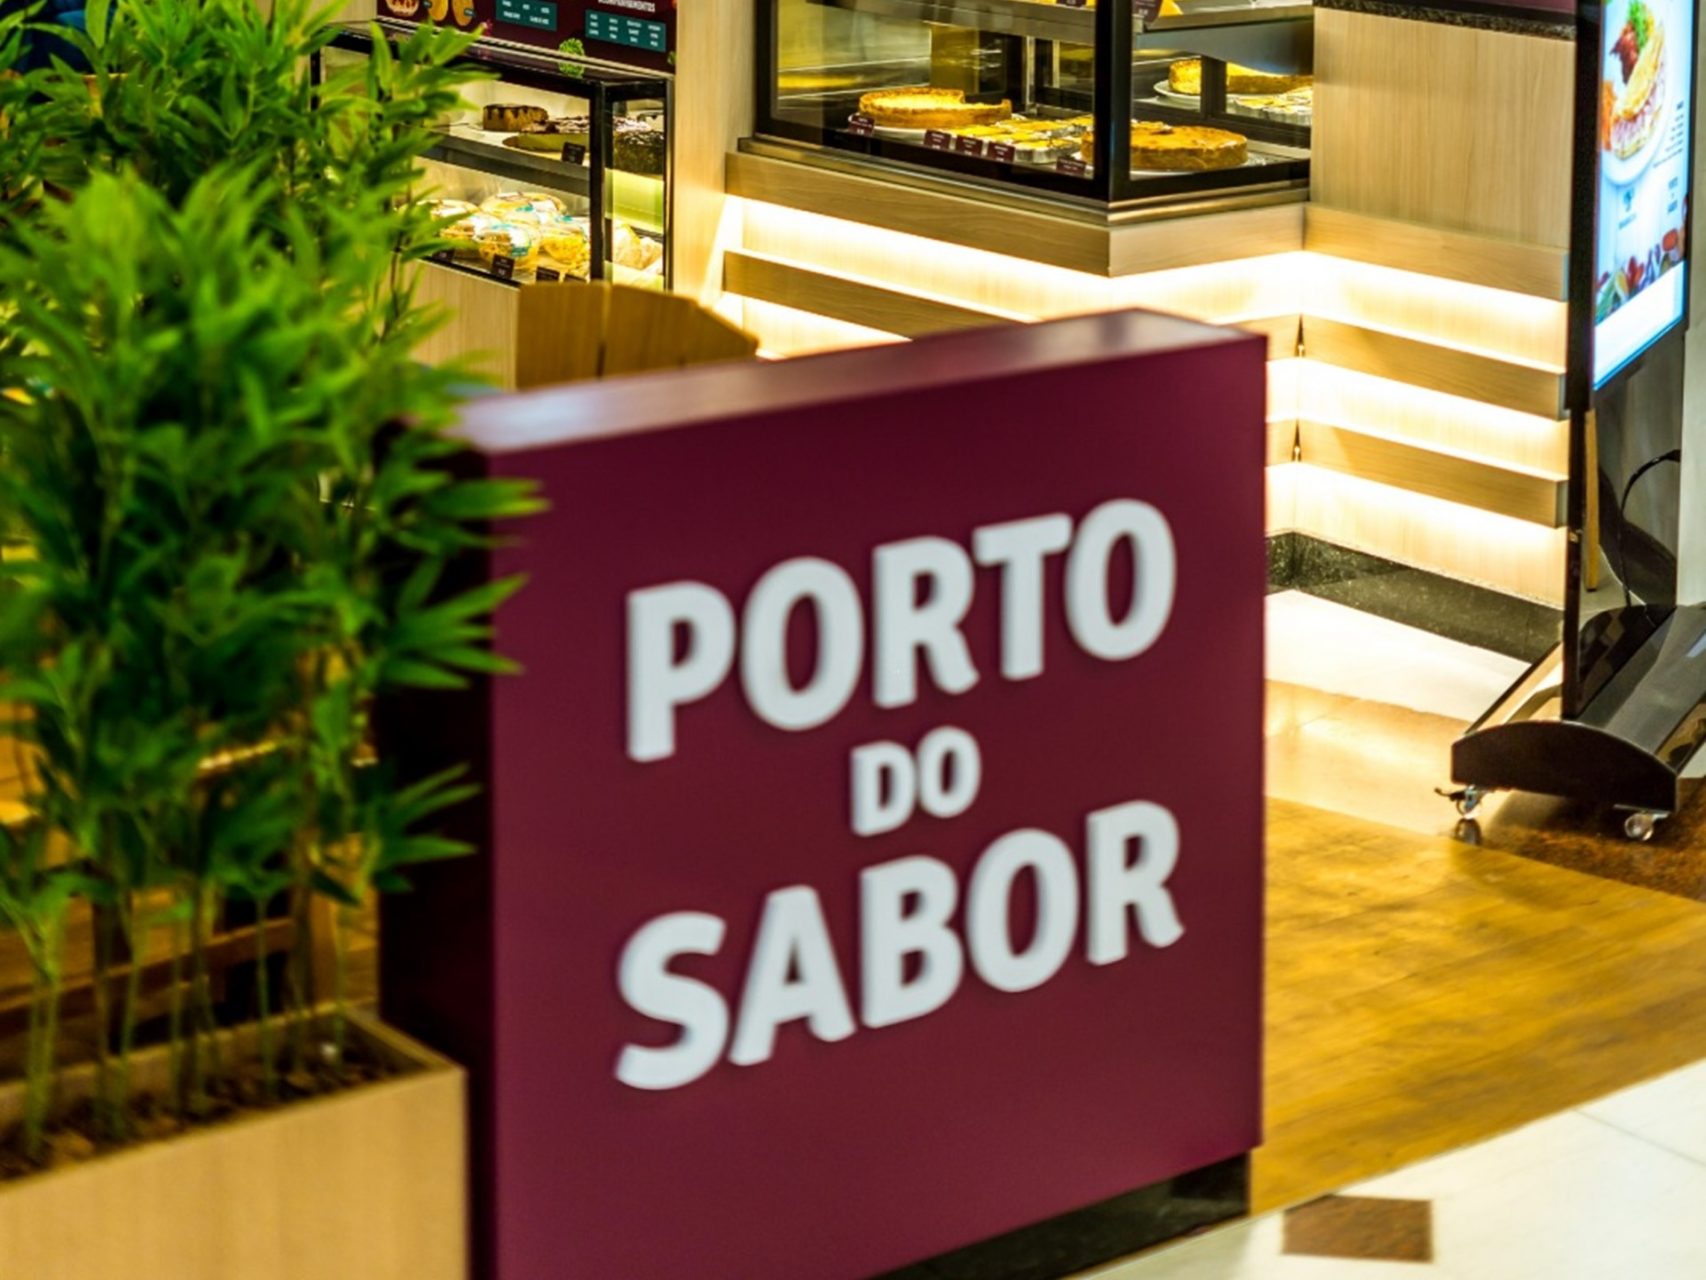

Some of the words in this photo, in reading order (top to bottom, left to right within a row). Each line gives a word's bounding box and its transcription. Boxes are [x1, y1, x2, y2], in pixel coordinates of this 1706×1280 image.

[626, 498, 1177, 763] PORTO
[850, 725, 982, 837] DO
[614, 799, 1186, 1091] SABOR
